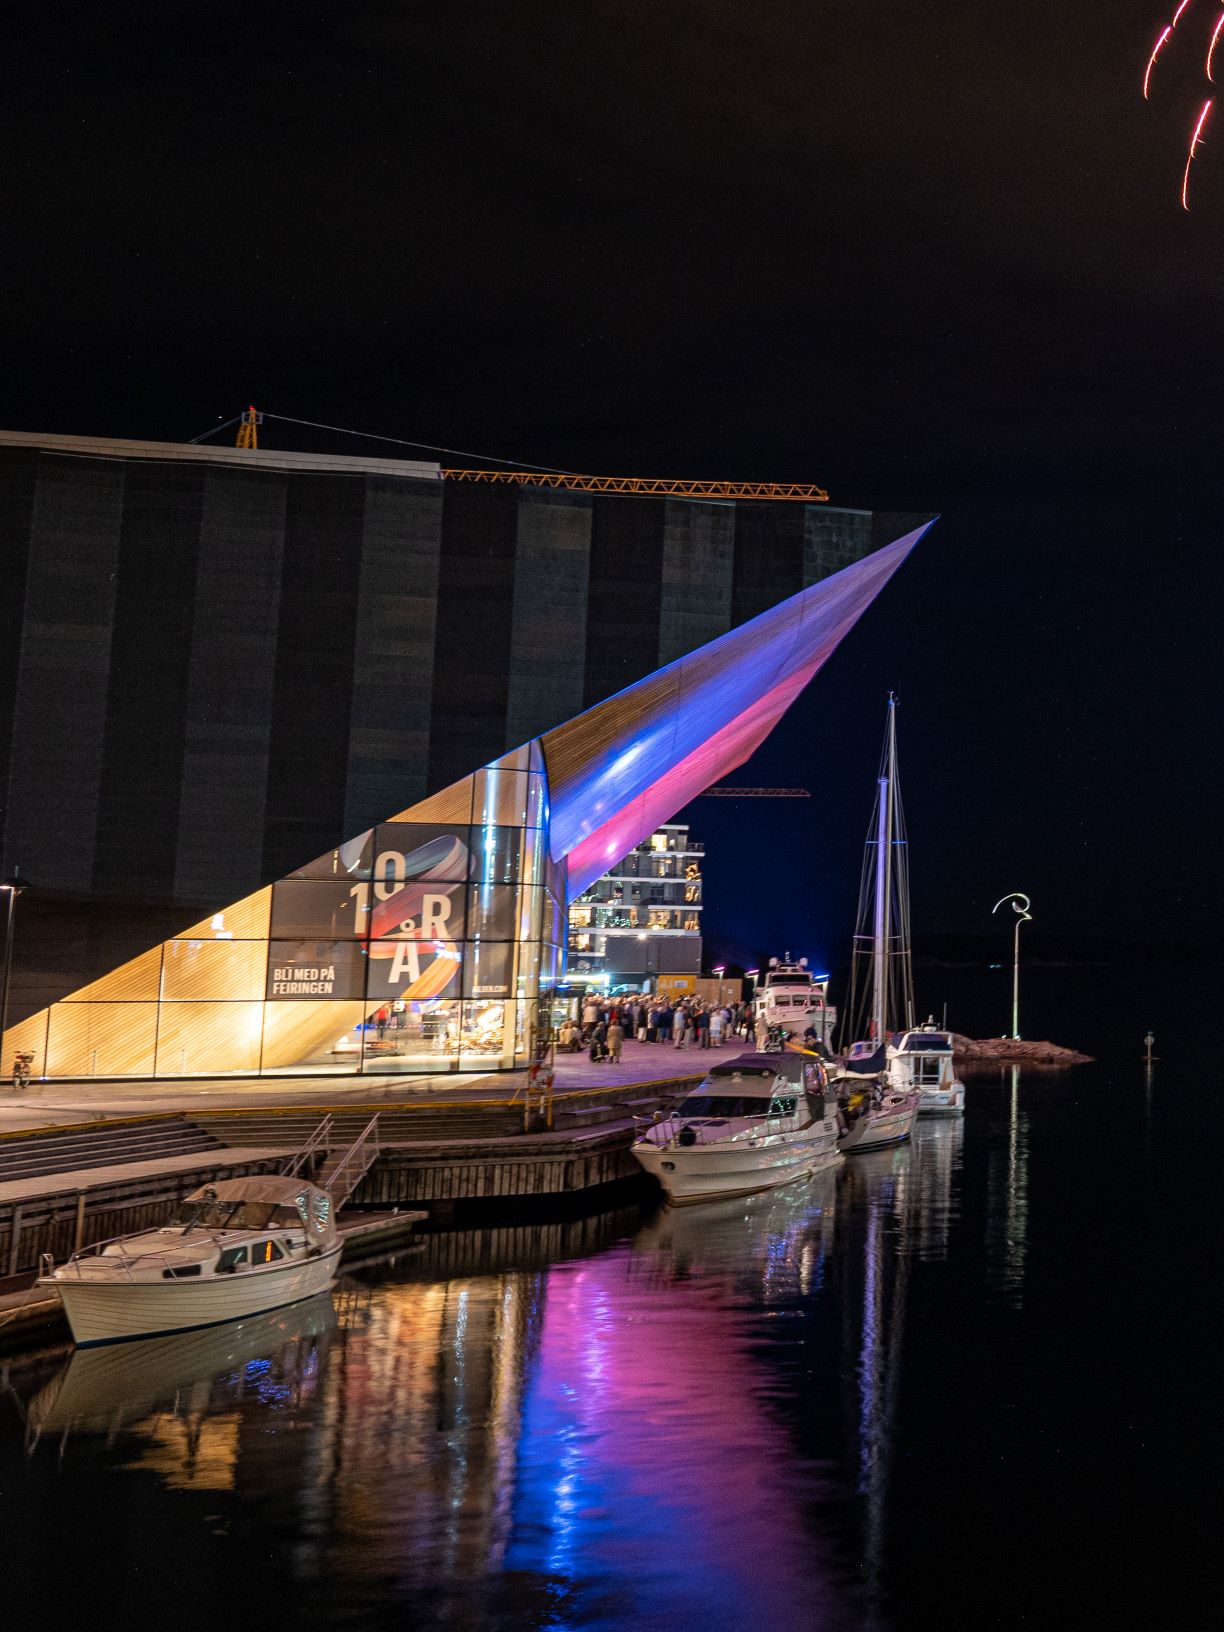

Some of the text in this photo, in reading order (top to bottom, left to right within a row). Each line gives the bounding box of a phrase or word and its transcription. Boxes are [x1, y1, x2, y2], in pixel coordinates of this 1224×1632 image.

[274, 965, 335, 981] BLI MED PÅ
[272, 981, 333, 994] FEIRINGEN
